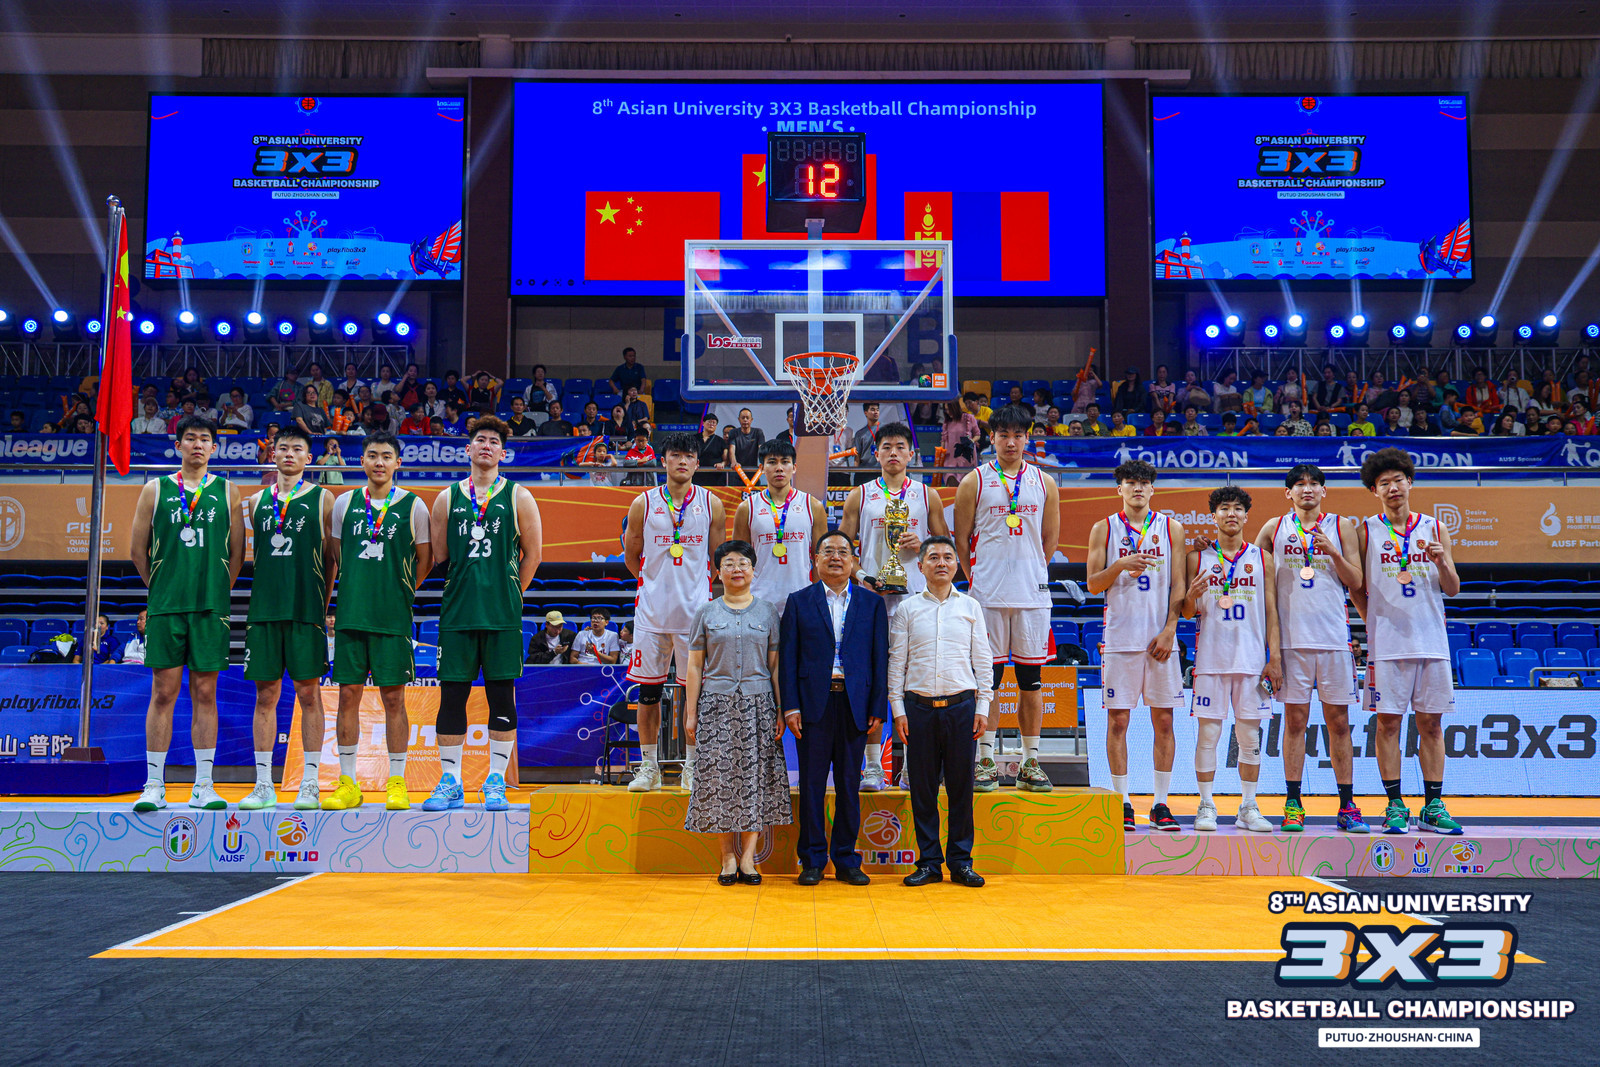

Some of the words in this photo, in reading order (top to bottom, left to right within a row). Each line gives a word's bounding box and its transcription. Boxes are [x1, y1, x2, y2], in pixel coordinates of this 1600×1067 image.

[617, 101, 668, 115] Asian
[674, 101, 764, 119] University
[769, 102, 802, 115] 3X3
[808, 101, 903, 116] Basketball
[908, 101, 1037, 119] Championship
[302, 137, 363, 145] UNIVERSITY
[1304, 137, 1365, 145] UNIVERSITY
[256, 151, 355, 173] 3X3
[1260, 151, 1358, 173] 3X3
[233, 179, 298, 187] BASKETBALL
[301, 180, 379, 188] CHAMPIONSHIP
[808, 163, 840, 198] 12
[1238, 179, 1303, 187] BASKETBALL
[1305, 180, 1384, 188] CHAMPIONSHIP
[0, 435, 88, 462] league
[398, 440, 515, 463] ealeae
[1138, 450, 1248, 468] QIAODAN
[1294, 457, 1320, 465] Sponsor
[1361, 450, 1473, 467] QODAN
[171, 507, 216, 523] 清大学
[1160, 509, 1219, 527] Realea
[263, 515, 306, 532] 清大学
[468, 539, 492, 558] 23
[1461, 539, 1499, 547] Sponsor
[1137, 575, 1150, 591] 9
[1402, 581, 1416, 597] 6
[634, 649, 642, 667] 8
[1040, 681, 1075, 689] ompeting
[1107, 689, 1115, 698] 9
[1196, 696, 1211, 707] 10
[0, 694, 116, 713] play.fibax3
[219, 854, 245, 862] AUSF
[265, 851, 319, 861] PUTUO
[1444, 865, 1484, 873] PUTUO
